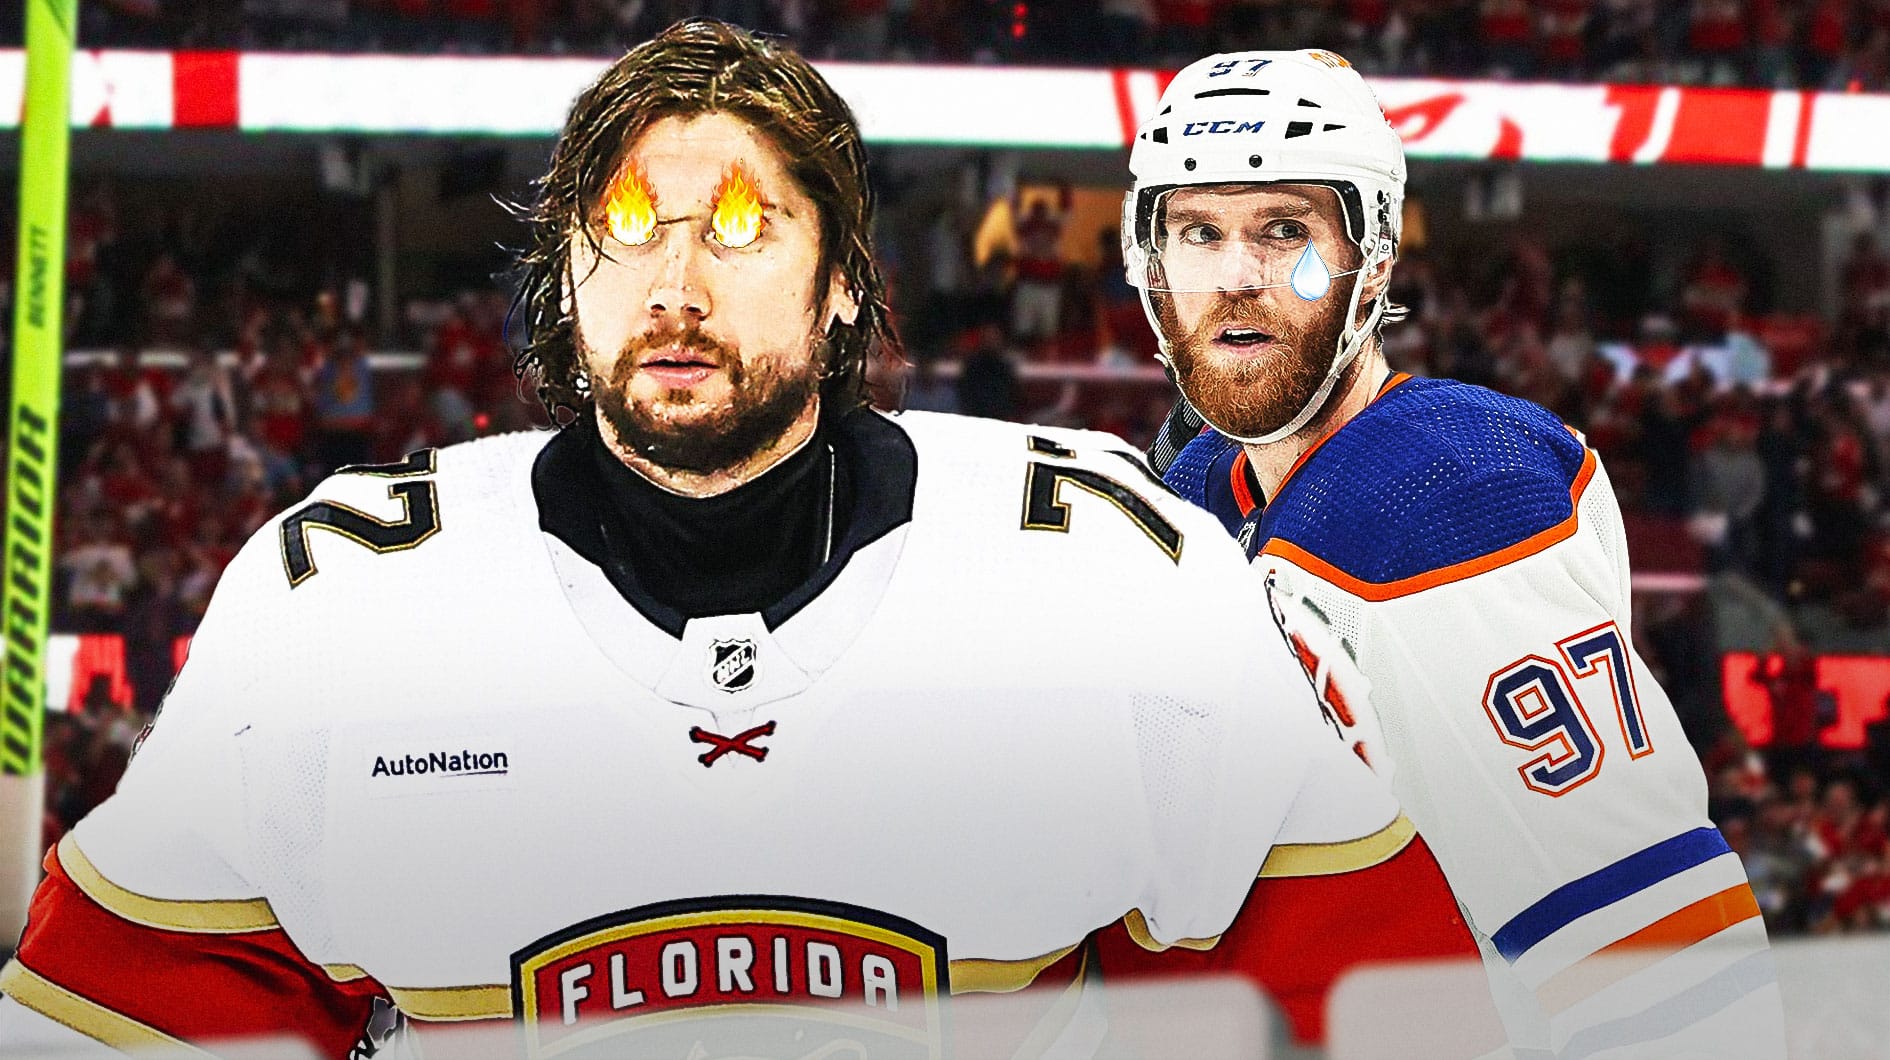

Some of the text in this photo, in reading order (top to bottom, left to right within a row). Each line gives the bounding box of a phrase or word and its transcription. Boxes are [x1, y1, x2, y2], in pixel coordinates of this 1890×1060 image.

[1183, 121, 1265, 136] CCM
[2, 402, 48, 776] WARRIOR
[1482, 620, 1654, 797] 97
[372, 750, 508, 777] AutoNation
[561, 936, 899, 1025] FLORIDA
